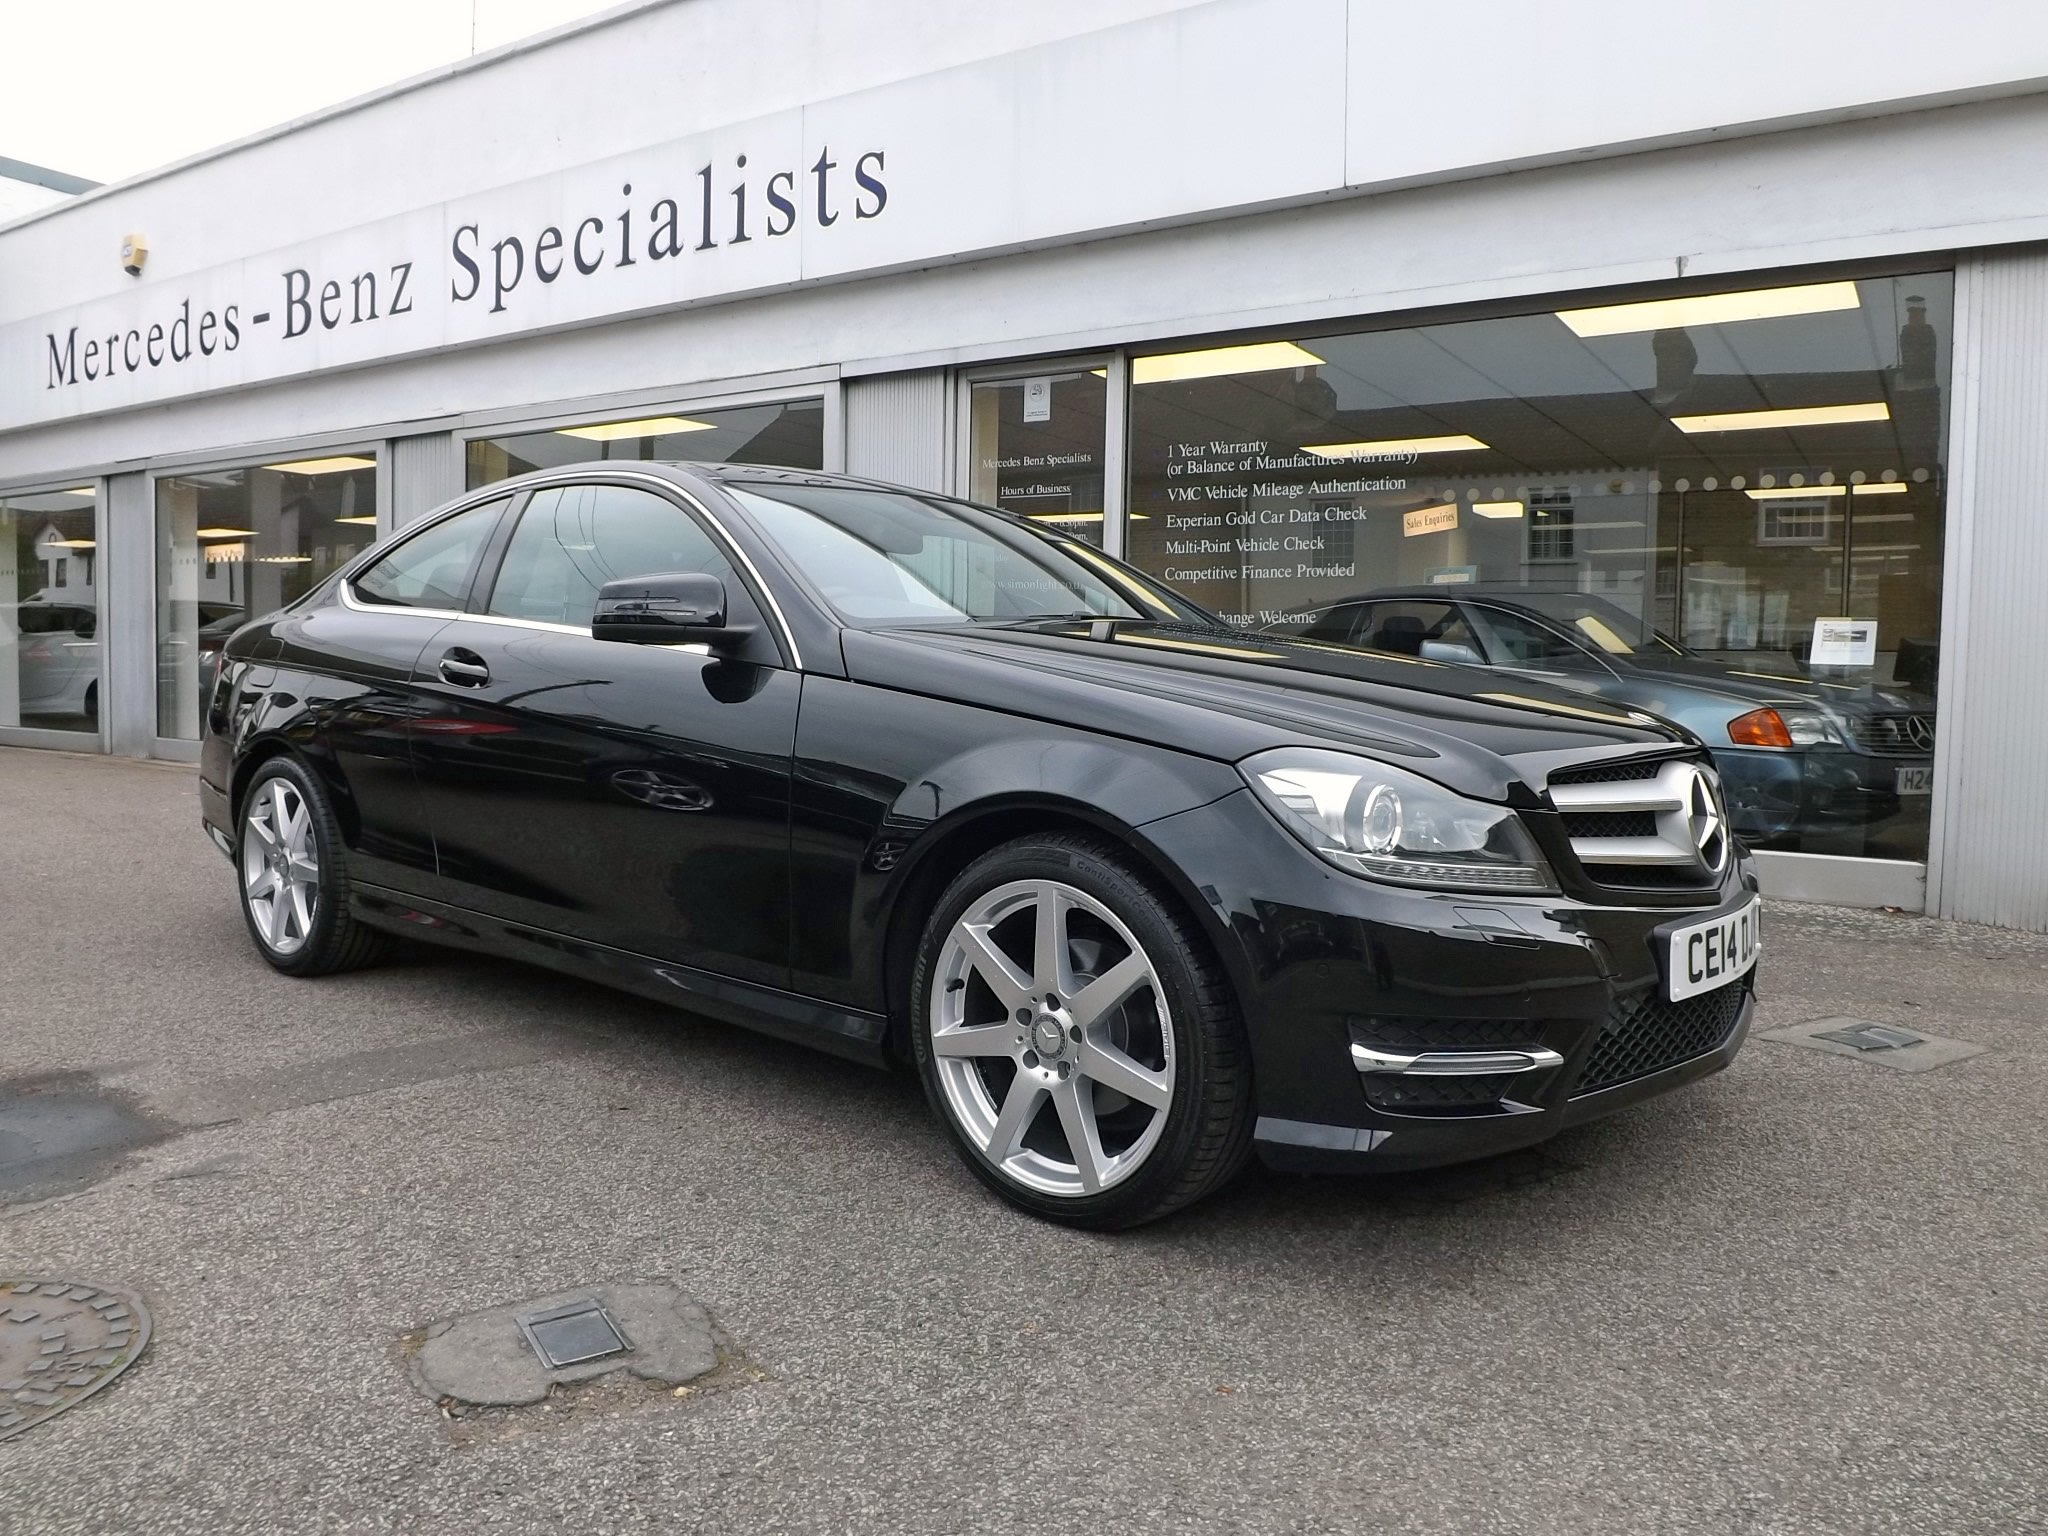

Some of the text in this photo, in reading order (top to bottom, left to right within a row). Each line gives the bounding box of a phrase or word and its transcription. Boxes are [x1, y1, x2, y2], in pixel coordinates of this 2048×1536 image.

[45, 147, 890, 391] Mercedes-Benz Specialists
[1167, 440, 1268, 458] 1 Year Warranty
[982, 452, 1092, 469] Mercedes Benz Specialists
[1167, 447, 1418, 479] (or Balance of Manufactures Warranty)
[1001, 484, 1071, 496] Hours of Business
[1167, 476, 1406, 501] VMC Vehicle Mileage Authentication
[1166, 506, 1367, 531] Experian Gold Car Data Check
[1407, 512, 1455, 530] Sales Enquiries
[1165, 536, 1325, 554] Multi-Point Vehicle Check
[1164, 563, 1355, 584] Competitive Finance Provided
[1216, 610, 1317, 628] hange Welcome
[1688, 920, 1737, 984] CE14
